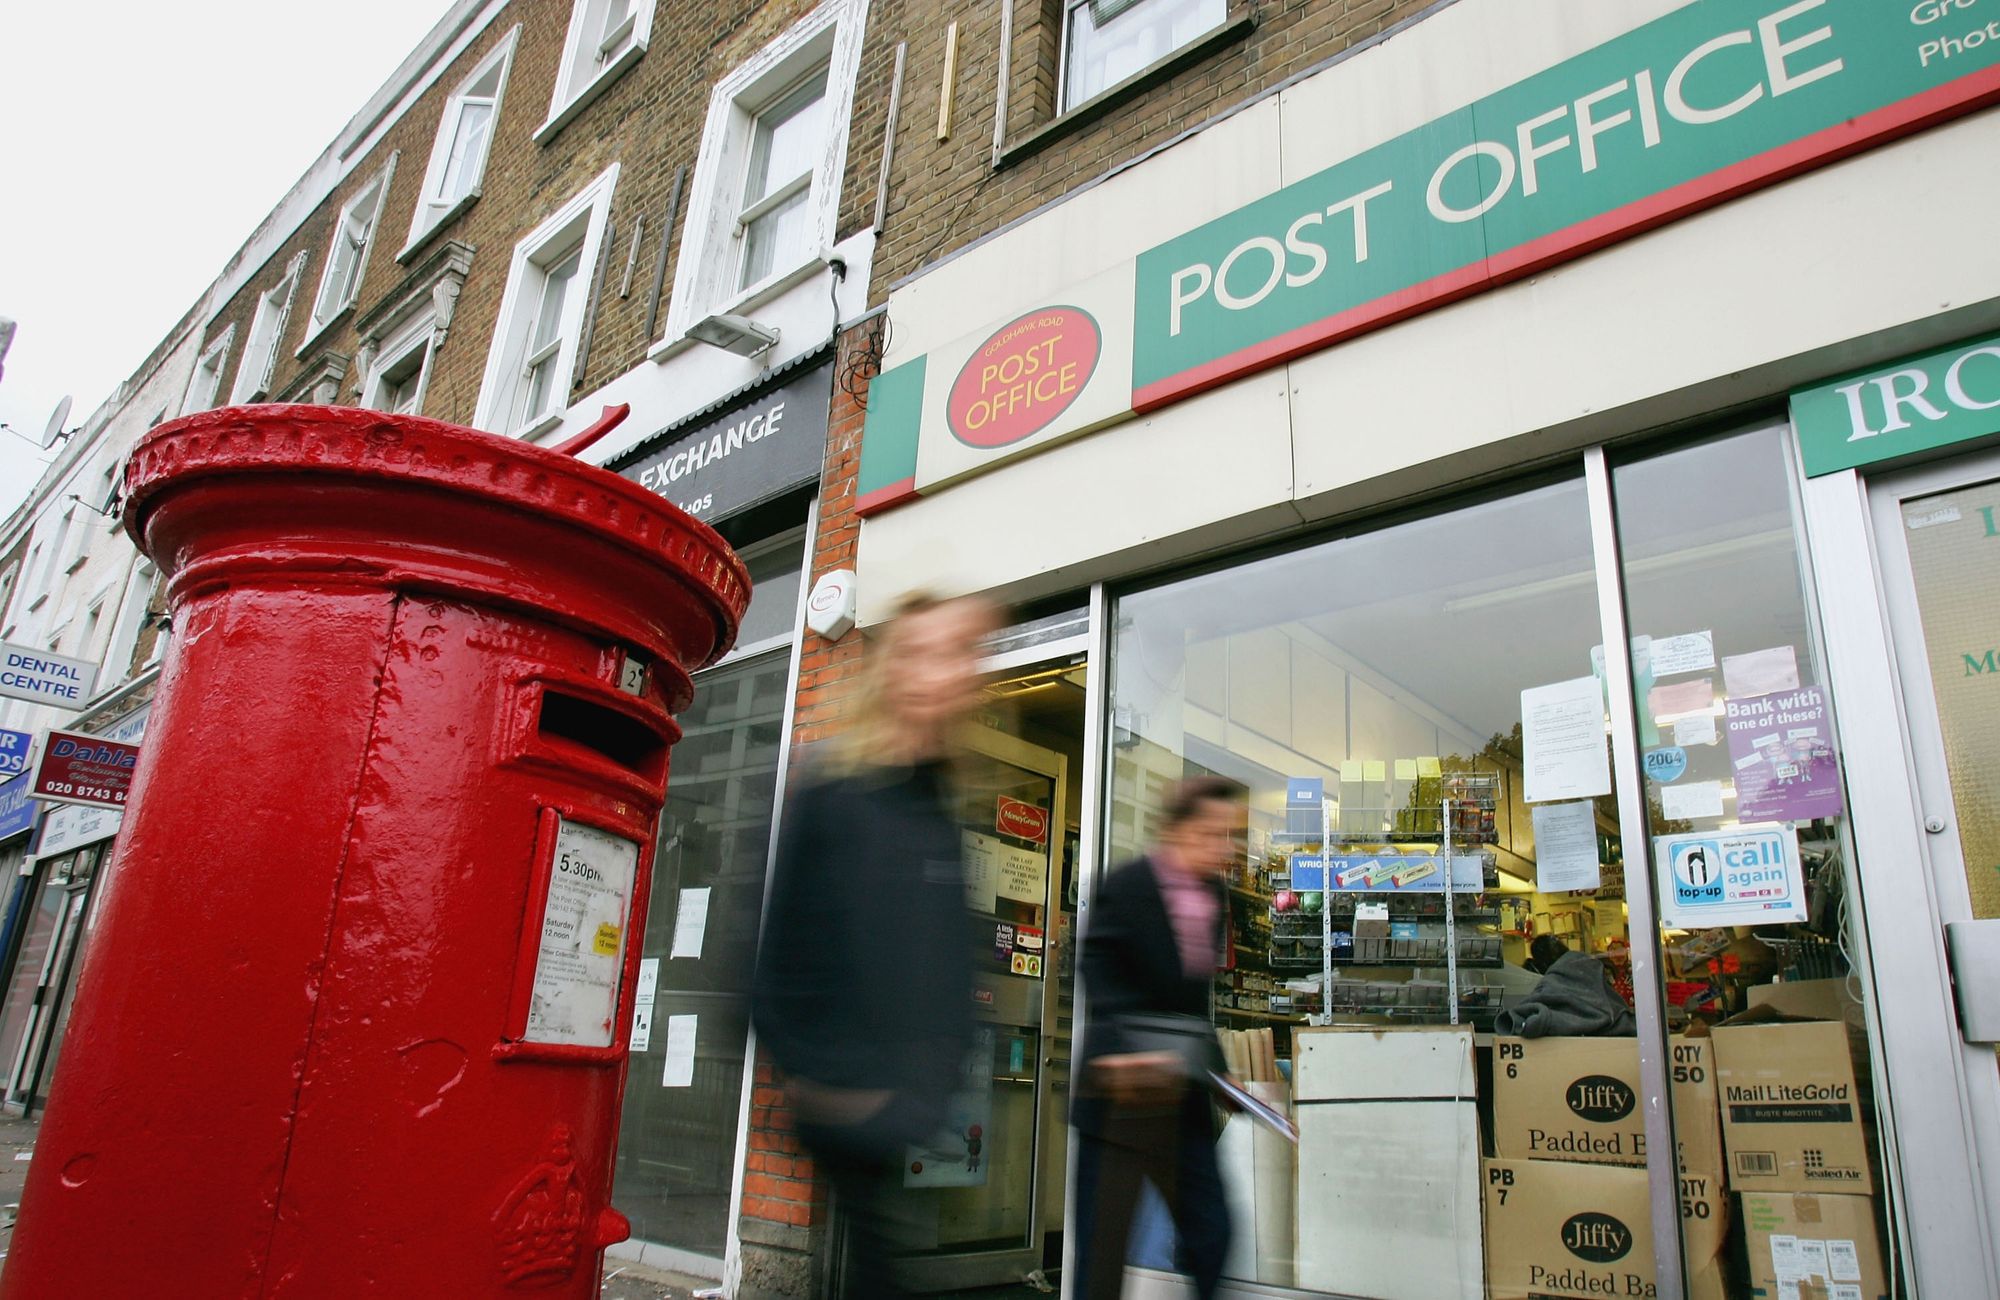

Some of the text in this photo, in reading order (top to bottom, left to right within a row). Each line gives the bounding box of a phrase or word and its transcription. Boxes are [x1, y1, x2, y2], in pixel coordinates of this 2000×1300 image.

[1169, 0, 1847, 338] POST OFFICE
[984, 316, 1064, 357] GOLDHAWK ROAD
[981, 334, 1063, 395] POST
[965, 361, 1077, 430] OFFICE
[639, 402, 786, 491] EXCHANGE
[7, 653, 81, 681] DENTAL
[1961, 649, 2000, 677] M
[1, 672, 80, 699] CENTRE
[627, 670, 637, 688] 2
[1727, 698, 1774, 718] Bank
[1777, 689, 1822, 711] with
[1730, 706, 1822, 731] one of these?
[1647, 752, 1682, 767] 2004
[46, 781, 72, 794] 020
[77, 786, 110, 800] 8743
[1003, 810, 1041, 828] MoneyGram
[1723, 841, 1741, 849] thank
[1725, 841, 1780, 868] call
[1298, 860, 1348, 869] WRIGEY'S
[1728, 867, 1783, 886] again
[1678, 887, 1722, 899] top-up
[546, 918, 574, 931] Saturday
[545, 929, 570, 940] 12 noon
[1499, 1043, 1524, 1060] PB
[1674, 1045, 1701, 1064] QTY
[1506, 1063, 1518, 1079] 6
[1673, 1066, 1705, 1083] 50
[1571, 1084, 1629, 1113] Jiffy
[1727, 1086, 1764, 1101] Mail
[1528, 1129, 1621, 1155] Padded
[1489, 1168, 1514, 1185] PB
[1804, 1169, 1861, 1179] Sealed Air
[1497, 1189, 1508, 1206] 7
[1566, 1221, 1626, 1253] Jiffy
[1528, 1265, 1615, 1294] Padded
